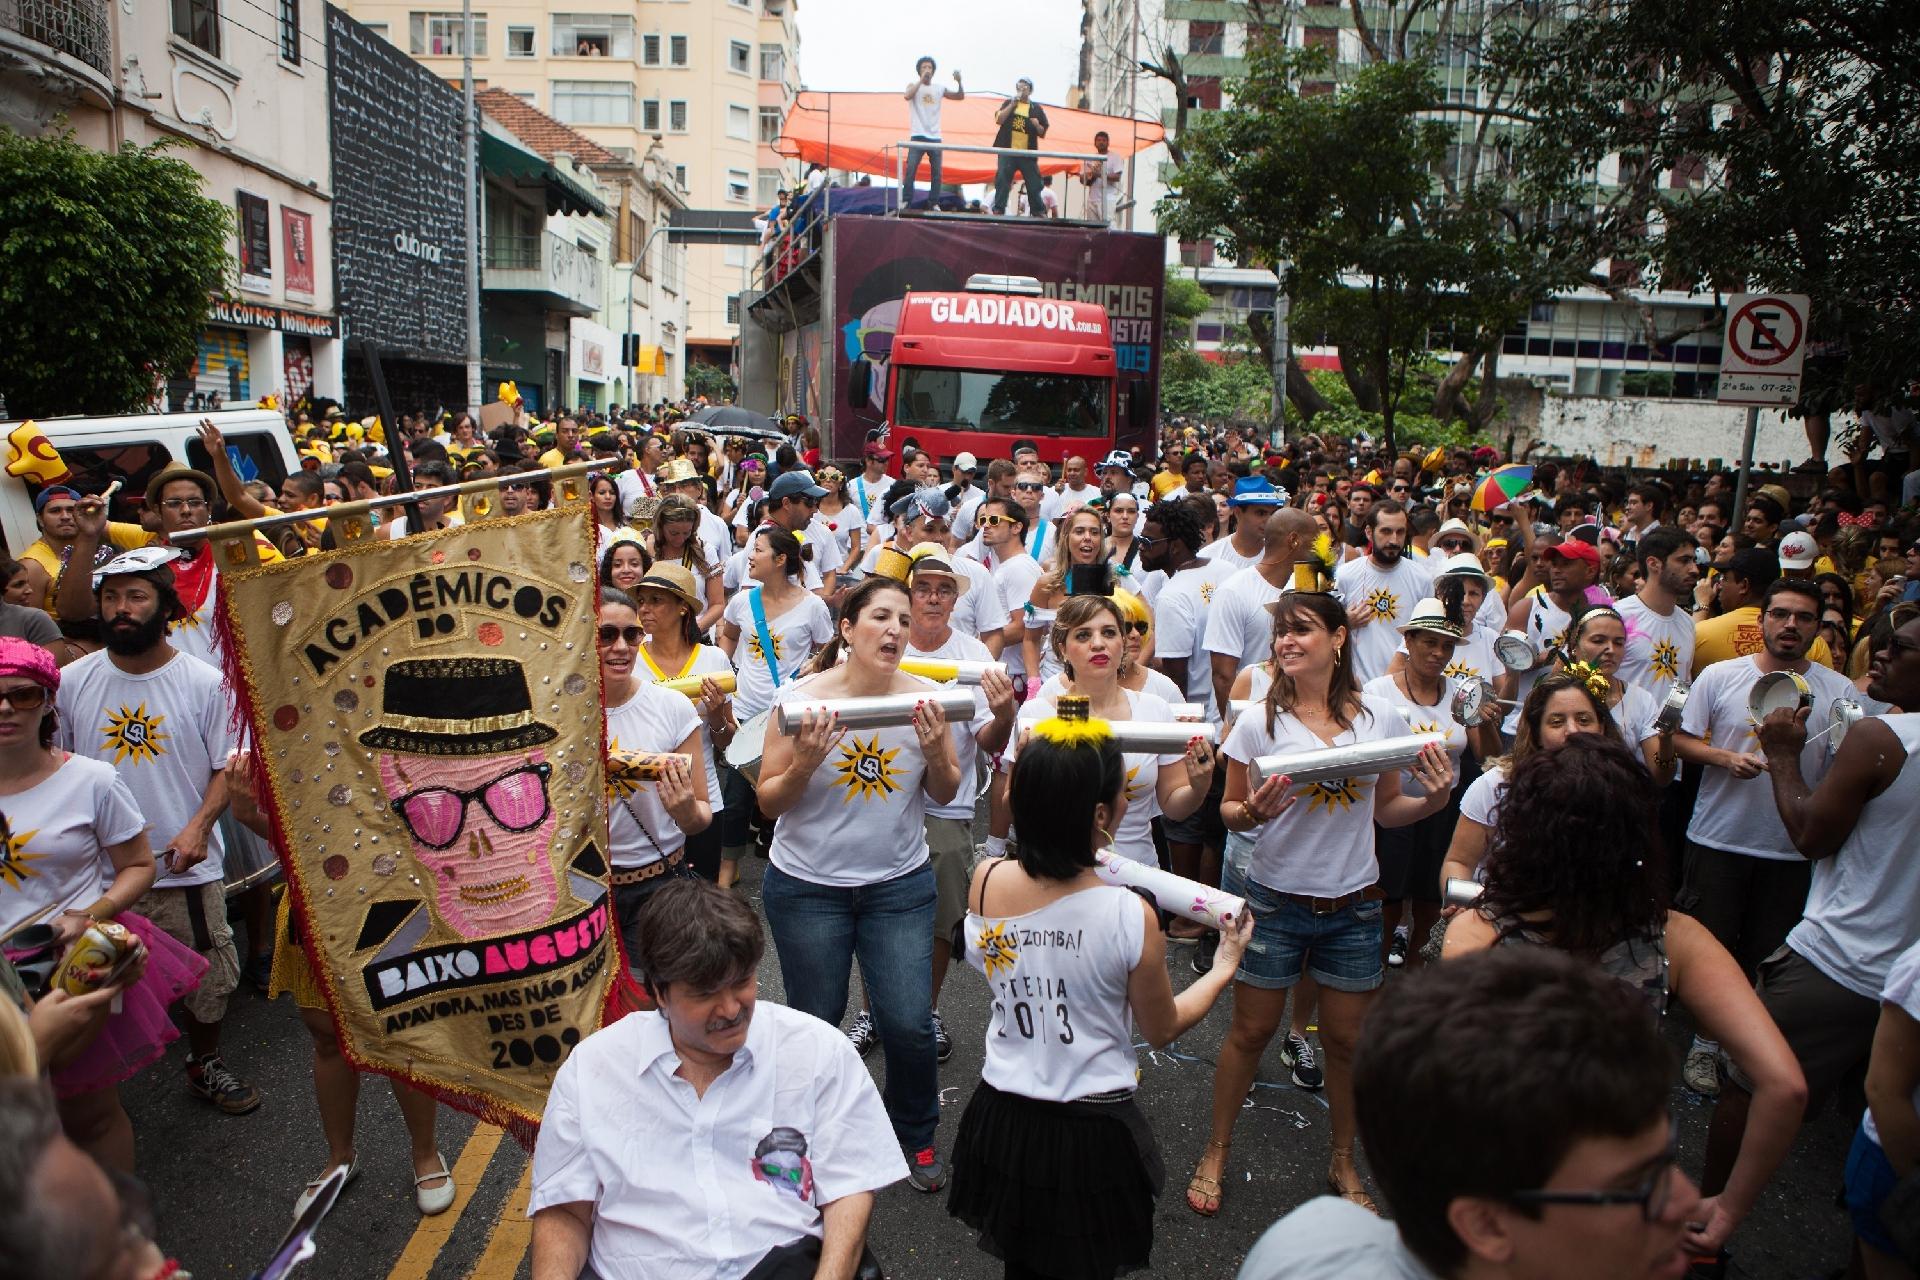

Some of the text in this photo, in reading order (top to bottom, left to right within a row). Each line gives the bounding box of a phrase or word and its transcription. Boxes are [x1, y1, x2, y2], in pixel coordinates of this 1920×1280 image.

[394, 229, 442, 264] club noir
[304, 571, 567, 676] ACADÊMICOS
[417, 613, 455, 638] DO
[377, 950, 479, 998] BAIXO
[995, 1002, 1074, 1044] 2013
